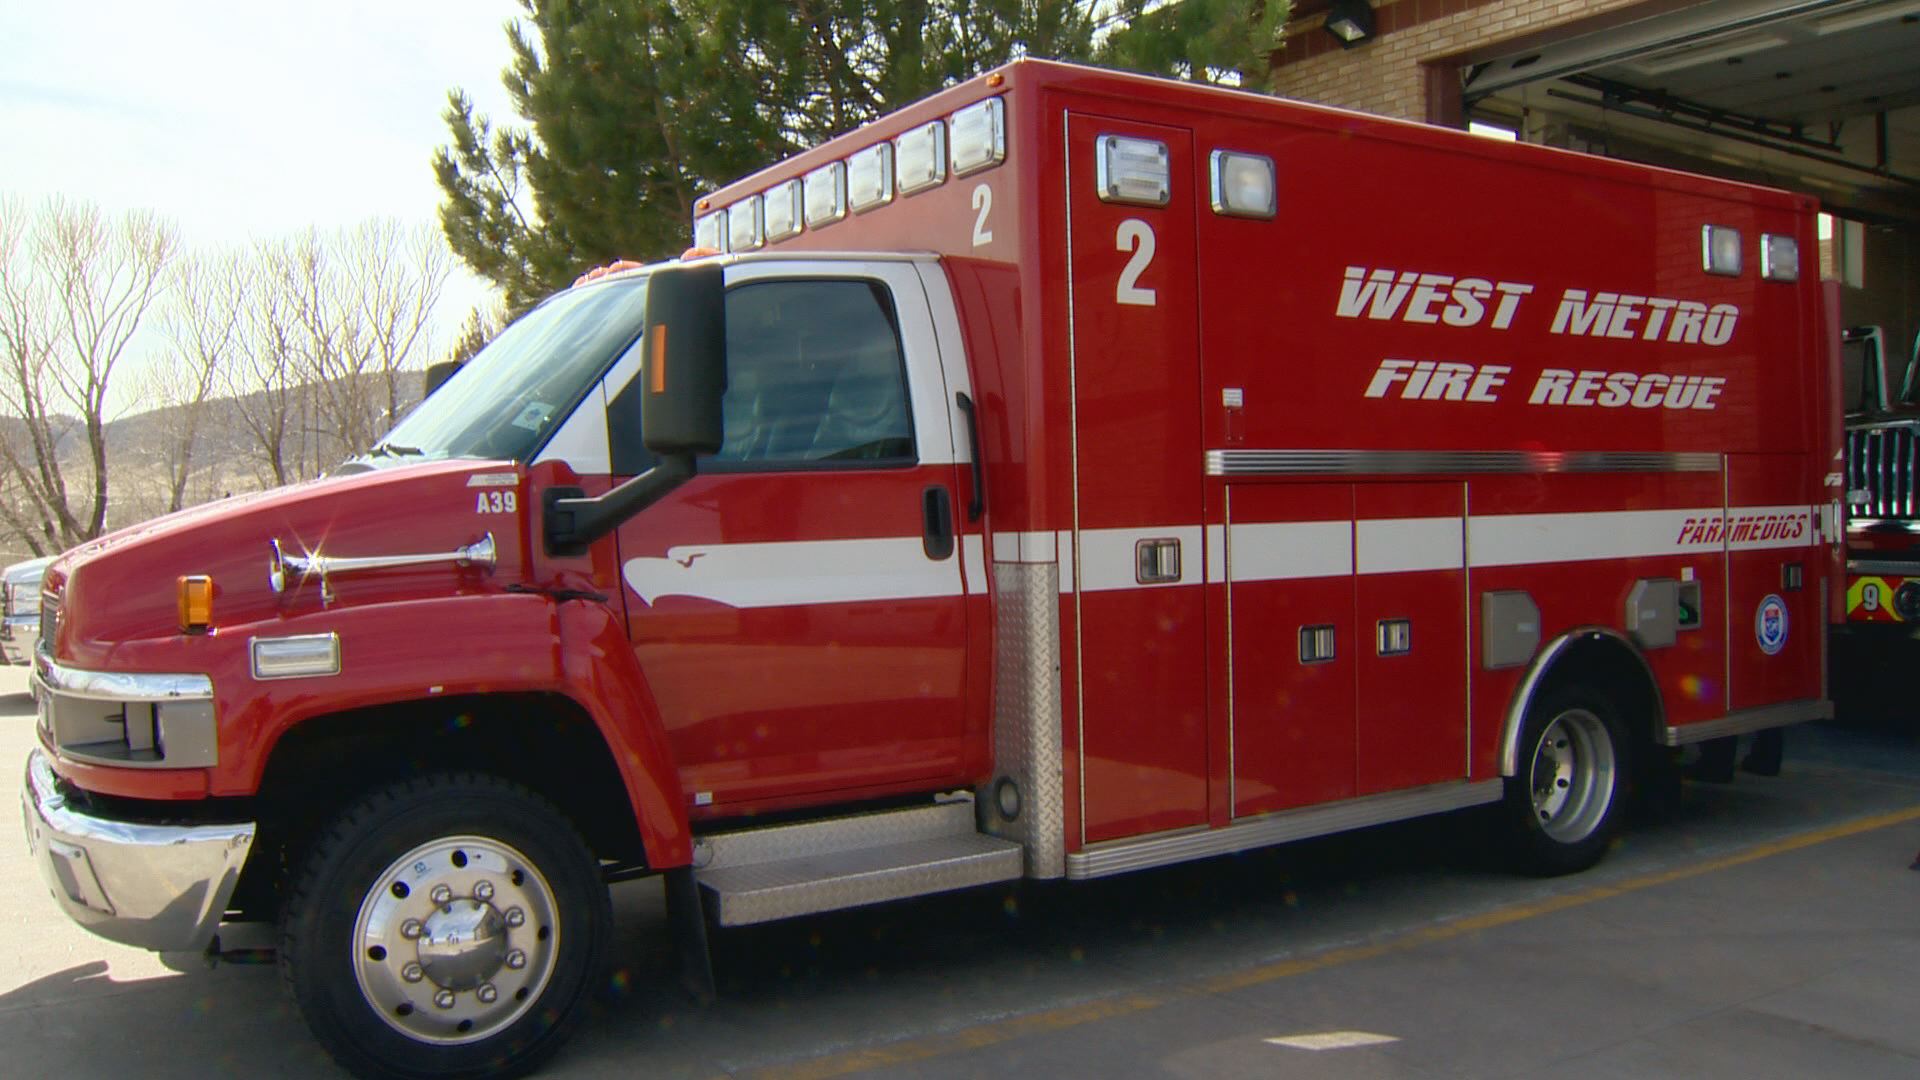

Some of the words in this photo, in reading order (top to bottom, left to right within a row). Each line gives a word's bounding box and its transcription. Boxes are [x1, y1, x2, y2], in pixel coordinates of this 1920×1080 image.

[972, 184, 993, 247] 2
[1116, 218, 1156, 306] 2
[1335, 266, 1534, 329] WEST
[1550, 288, 1740, 346] METRO
[1364, 358, 1512, 403] FIRE
[1528, 368, 1727, 410] RESCUE
[476, 491, 517, 513] A39
[1677, 513, 1807, 544] PARAMEDICS
[1862, 584, 1879, 612] 9
